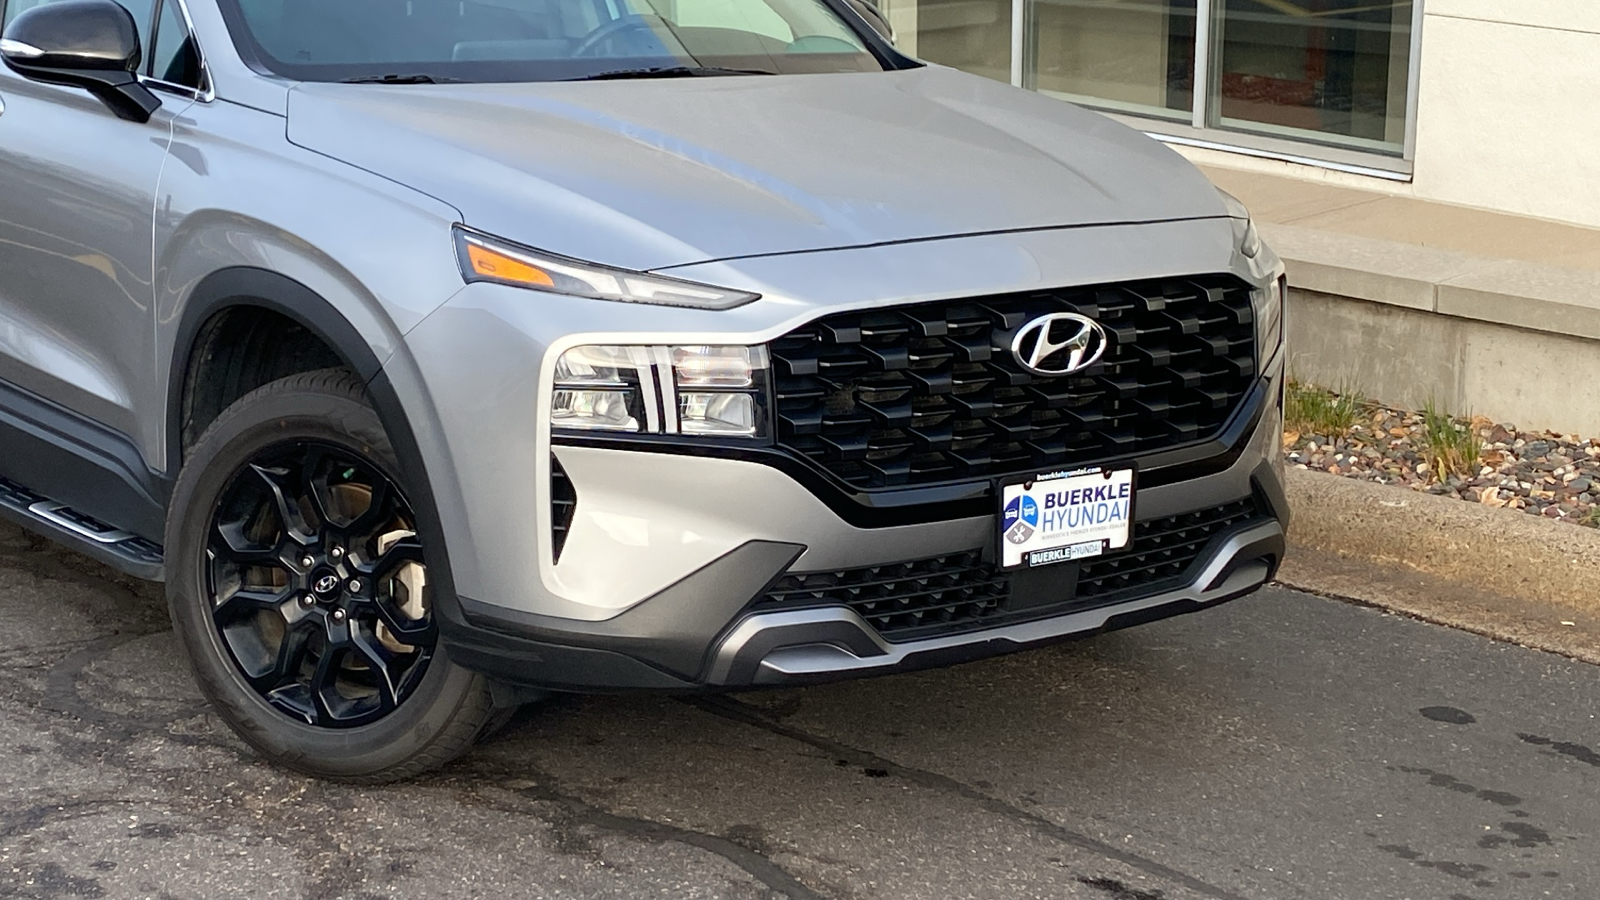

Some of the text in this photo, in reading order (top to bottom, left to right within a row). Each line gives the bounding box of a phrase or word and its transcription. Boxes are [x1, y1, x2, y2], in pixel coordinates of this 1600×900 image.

[1044, 482, 1131, 510] BUERKLE
[1042, 500, 1129, 533] HYUNDAI
[1031, 543, 1100, 564] BUERKLE HYUNDAI
